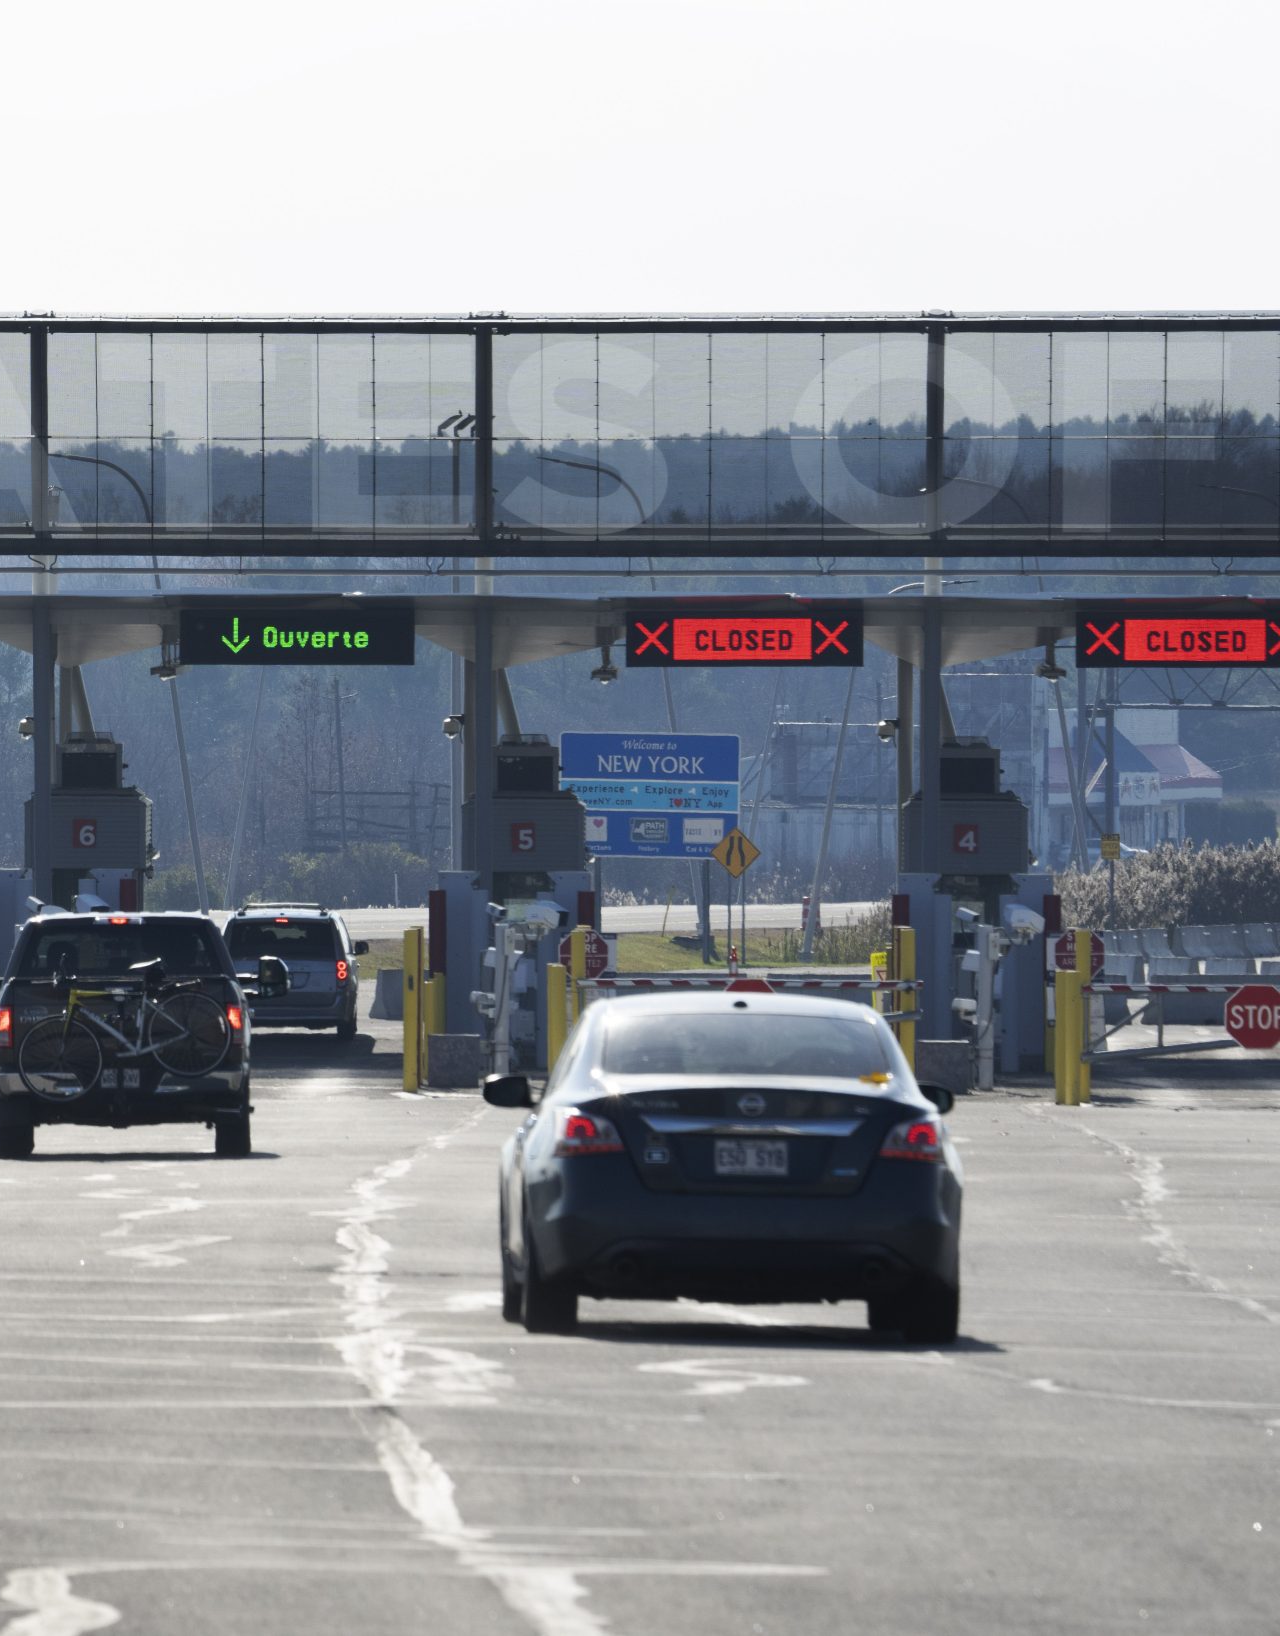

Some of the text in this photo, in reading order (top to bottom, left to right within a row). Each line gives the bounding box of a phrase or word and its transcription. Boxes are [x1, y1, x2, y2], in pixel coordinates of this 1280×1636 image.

[789, 337, 1232, 535] OF
[263, 626, 369, 648] Ouverte
[695, 629, 793, 651] CLOSED
[1147, 630, 1246, 652] CLOSED
[622, 739, 677, 750] Welcome to
[597, 755, 705, 774] NEW YORK
[570, 783, 729, 798] Experience Explore Enjoy
[706, 800, 723, 808] App
[79, 825, 95, 846] 6
[518, 829, 533, 850] 5
[959, 831, 976, 851] 4
[585, 933, 597, 943] OP
[585, 944, 598, 953] RE
